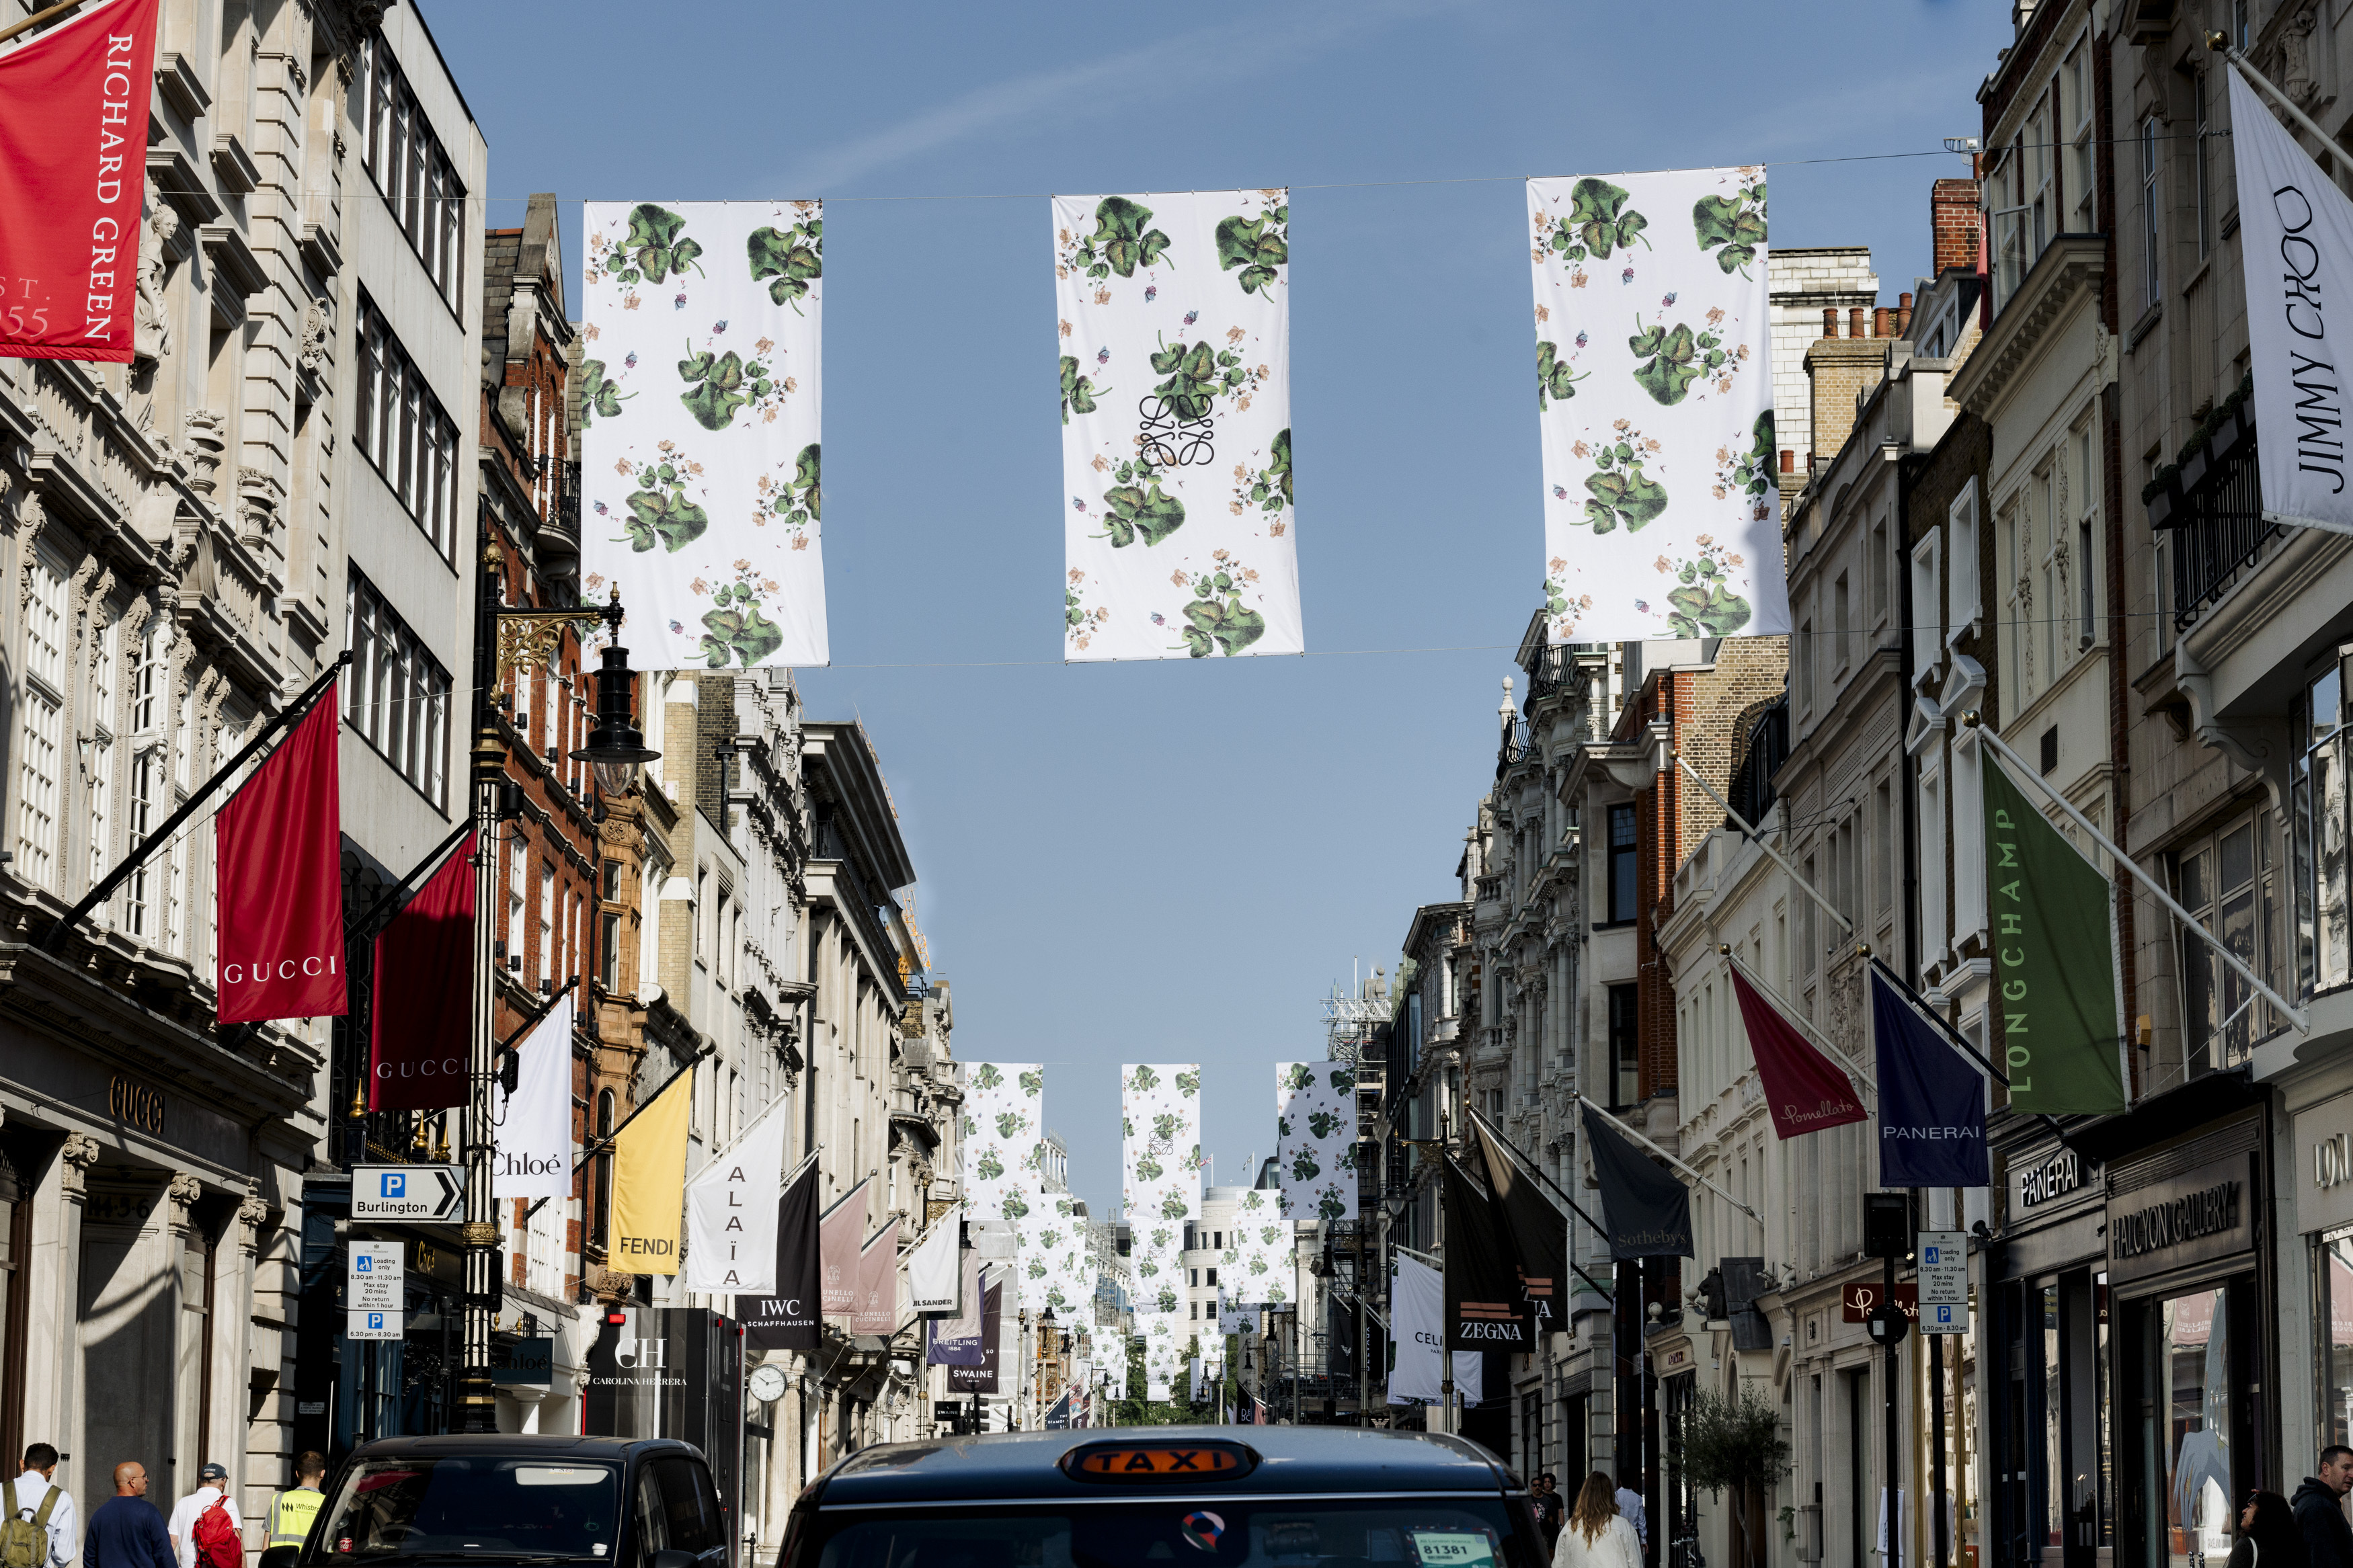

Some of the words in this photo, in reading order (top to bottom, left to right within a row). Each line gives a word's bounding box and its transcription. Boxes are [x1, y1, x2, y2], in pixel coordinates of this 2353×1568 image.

[97, 34, 132, 204] RICHARD
[2274, 185, 2324, 340] CHOO
[0, 276, 50, 300] T.
[85, 217, 119, 341] GREEN
[0, 306, 48, 337] 55
[2290, 350, 2345, 494] JIMMY
[1996, 809, 2032, 1092] LONGCHAMP
[224, 956, 336, 984] GUCCI
[376, 1058, 469, 1079] GUCCI
[110, 1076, 166, 1134] GUCCI
[1781, 1098, 1854, 1124] Pomellato
[1884, 1126, 1979, 1140] PANERAI
[492, 1153, 561, 1177] Chloé
[2313, 1133, 2353, 1189] LON
[2022, 1154, 2078, 1207] PANERAI
[357, 1201, 428, 1214] Burlington
[2112, 1202, 2169, 1260] HALCYON
[2173, 1181, 2232, 1242] GALLERY
[723, 1166, 746, 1285] ALAÏA
[1618, 1229, 1686, 1248] Sotheby's
[620, 1238, 673, 1256] FENDI
[761, 1299, 800, 1316] IWC
[1415, 1332, 1443, 1346] CELI
[1460, 1322, 1523, 1340] ZEGNA
[615, 1338, 667, 1368] CH
[1096, 1452, 1223, 1471] TAXI
[1424, 1546, 1467, 1554] 81381
